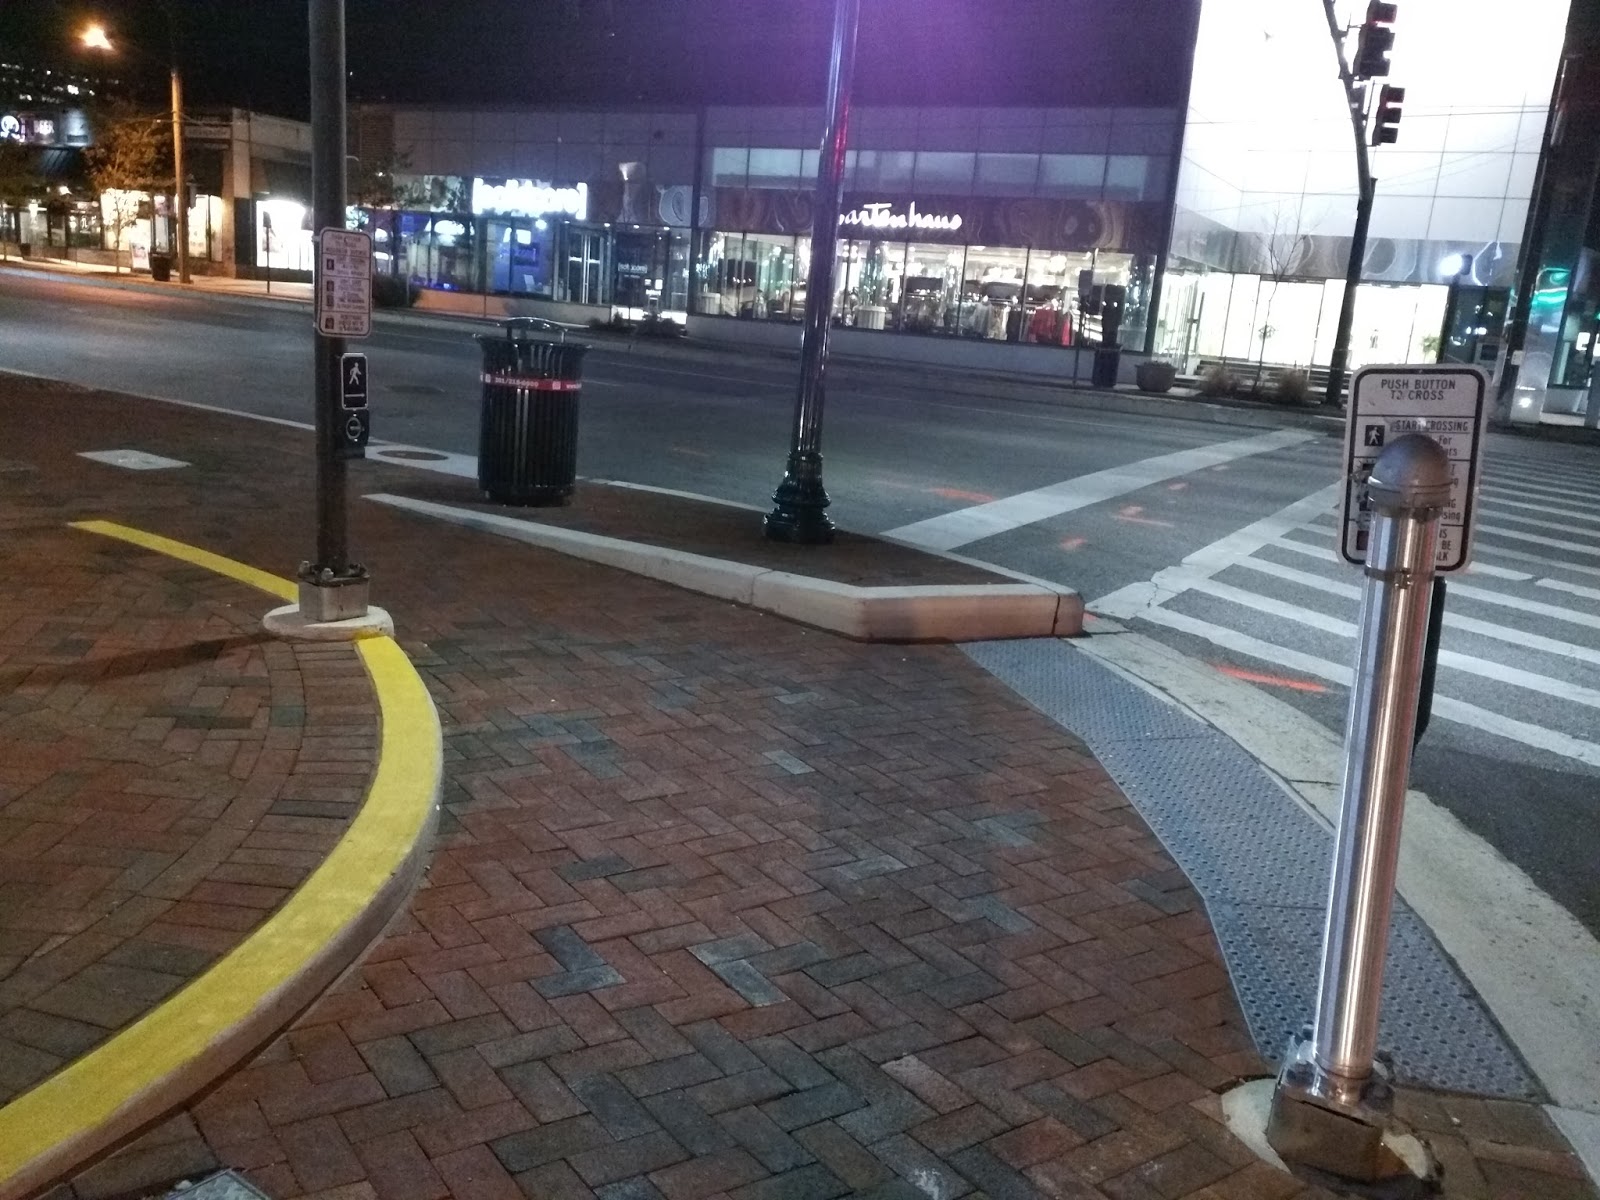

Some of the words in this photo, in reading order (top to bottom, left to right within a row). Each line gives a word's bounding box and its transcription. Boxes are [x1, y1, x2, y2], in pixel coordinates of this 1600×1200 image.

[838, 201, 963, 230] artenhaus
[1380, 379, 1409, 390] PUSH
[1414, 379, 1456, 390] BUTTON
[1408, 390, 1444, 400] CROSS
[1426, 420, 1469, 431] CROSSING
